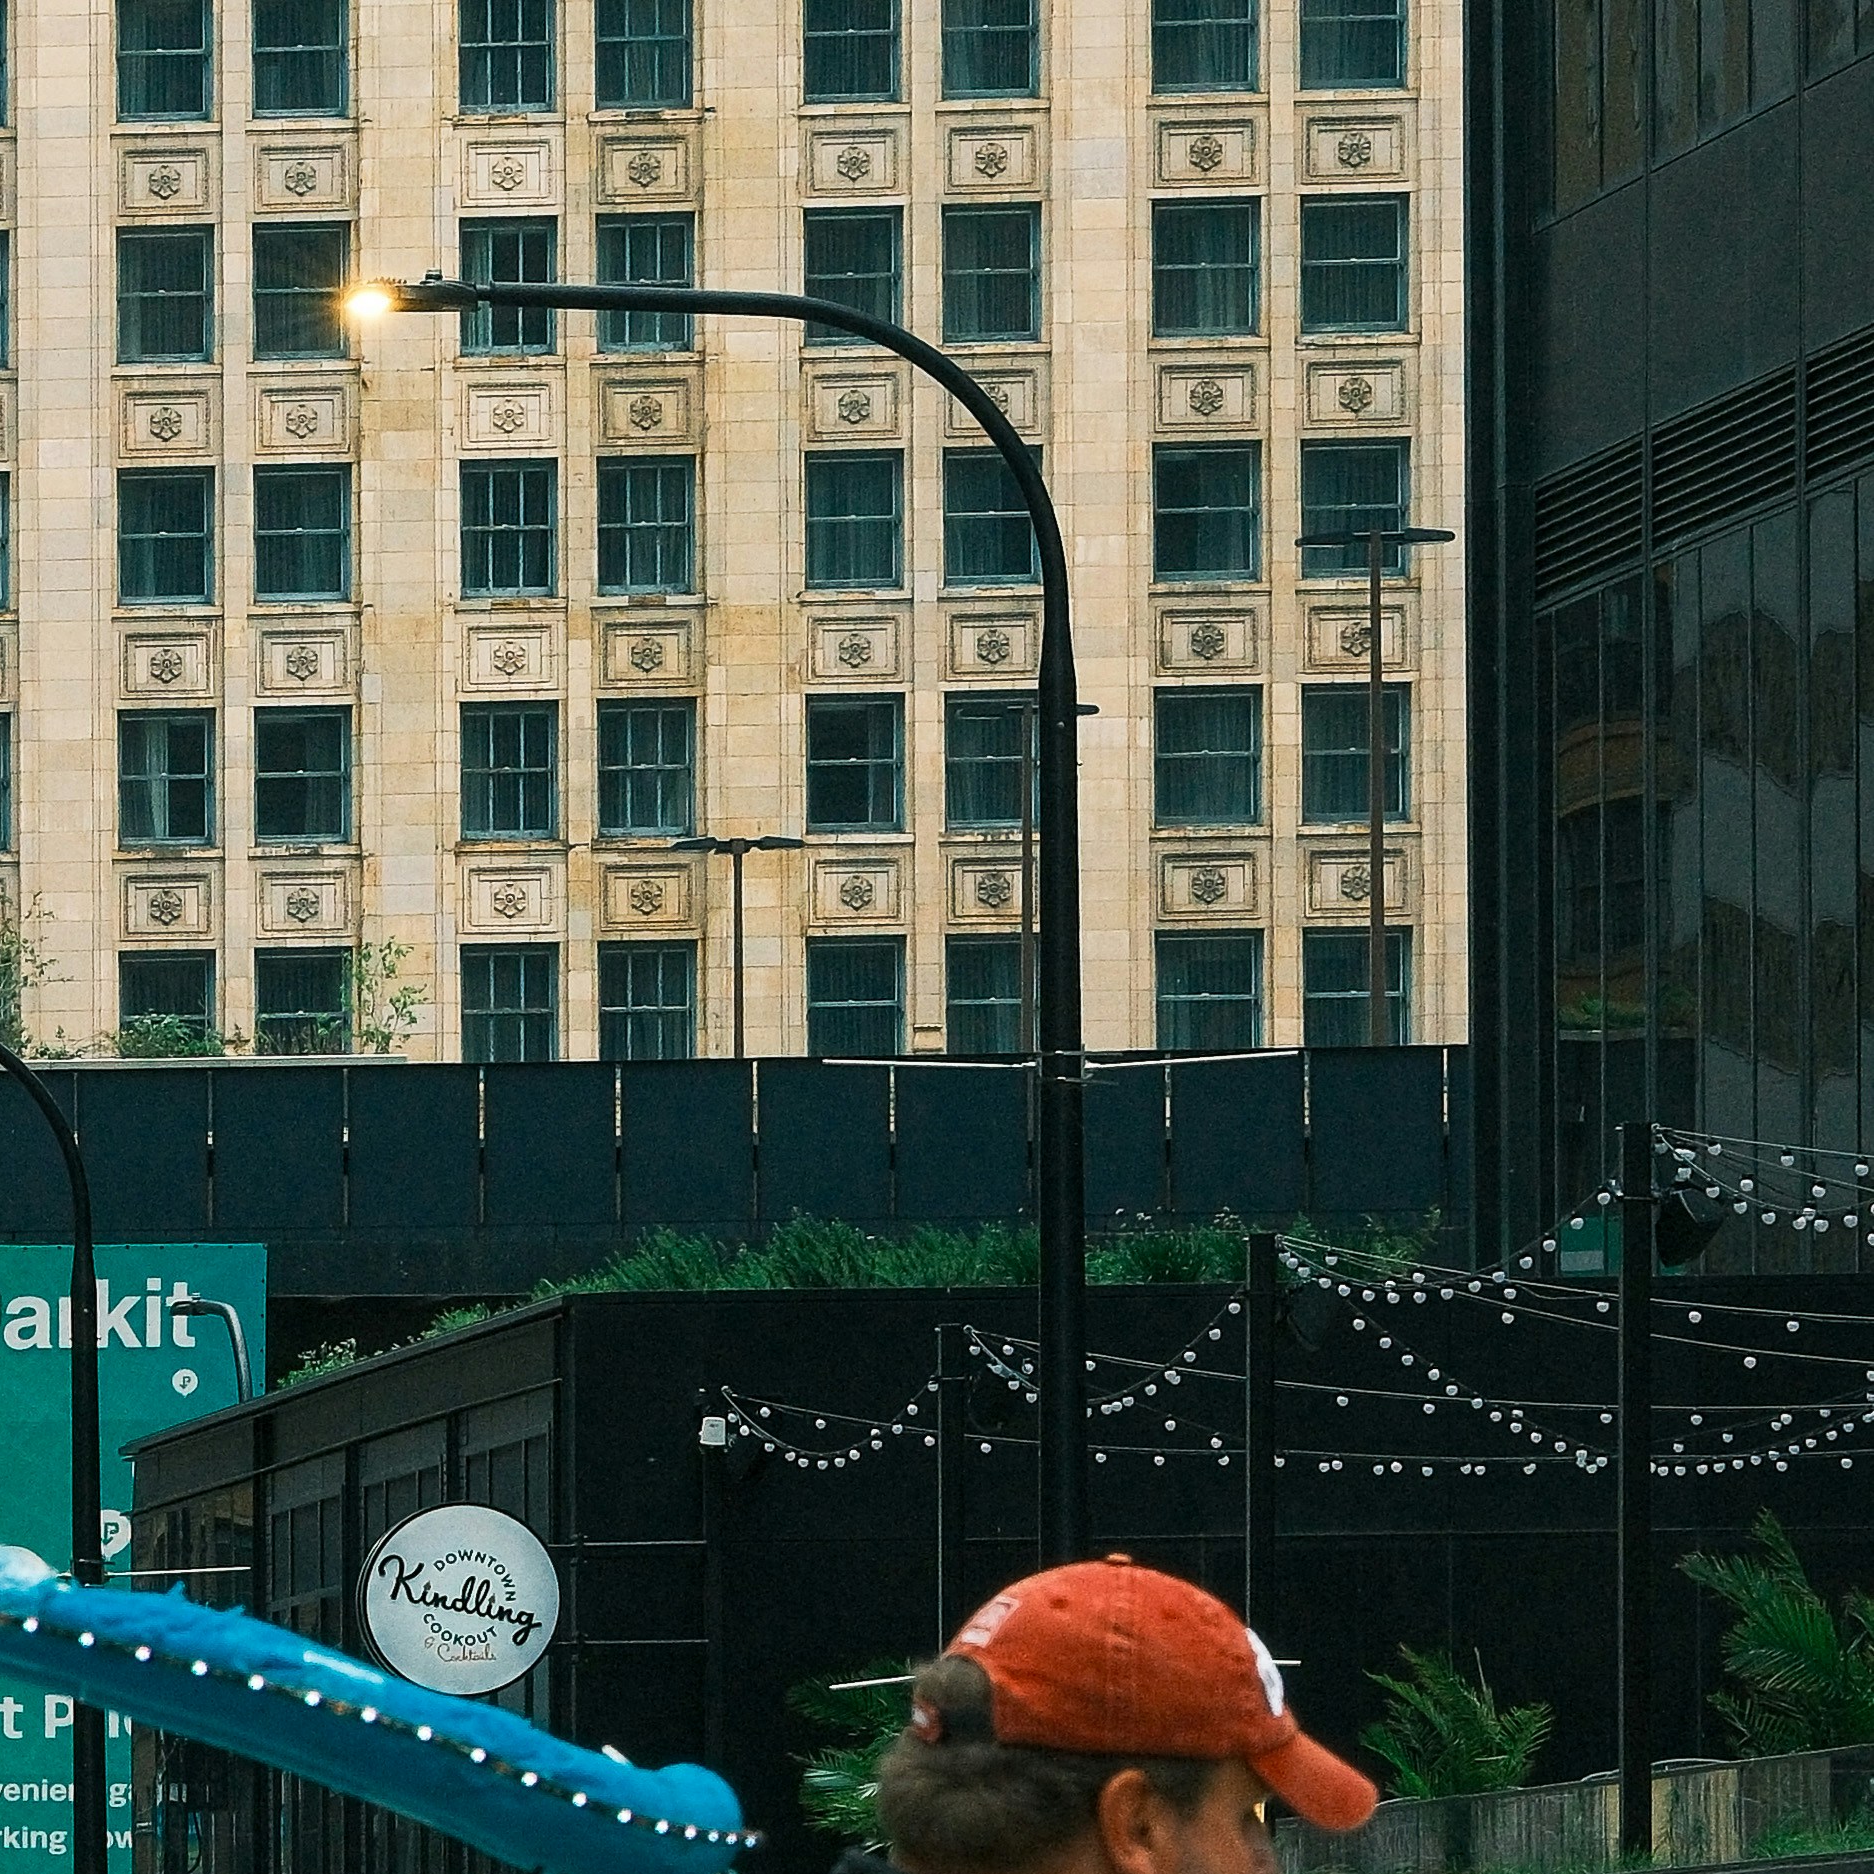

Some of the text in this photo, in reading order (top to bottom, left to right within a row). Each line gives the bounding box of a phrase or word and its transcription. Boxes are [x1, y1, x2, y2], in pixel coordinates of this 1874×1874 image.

[377, 1554, 543, 1647] Kindling
[433, 1549, 517, 1602] DOWNTOWN
[423, 1613, 498, 1647] COOKOUT
